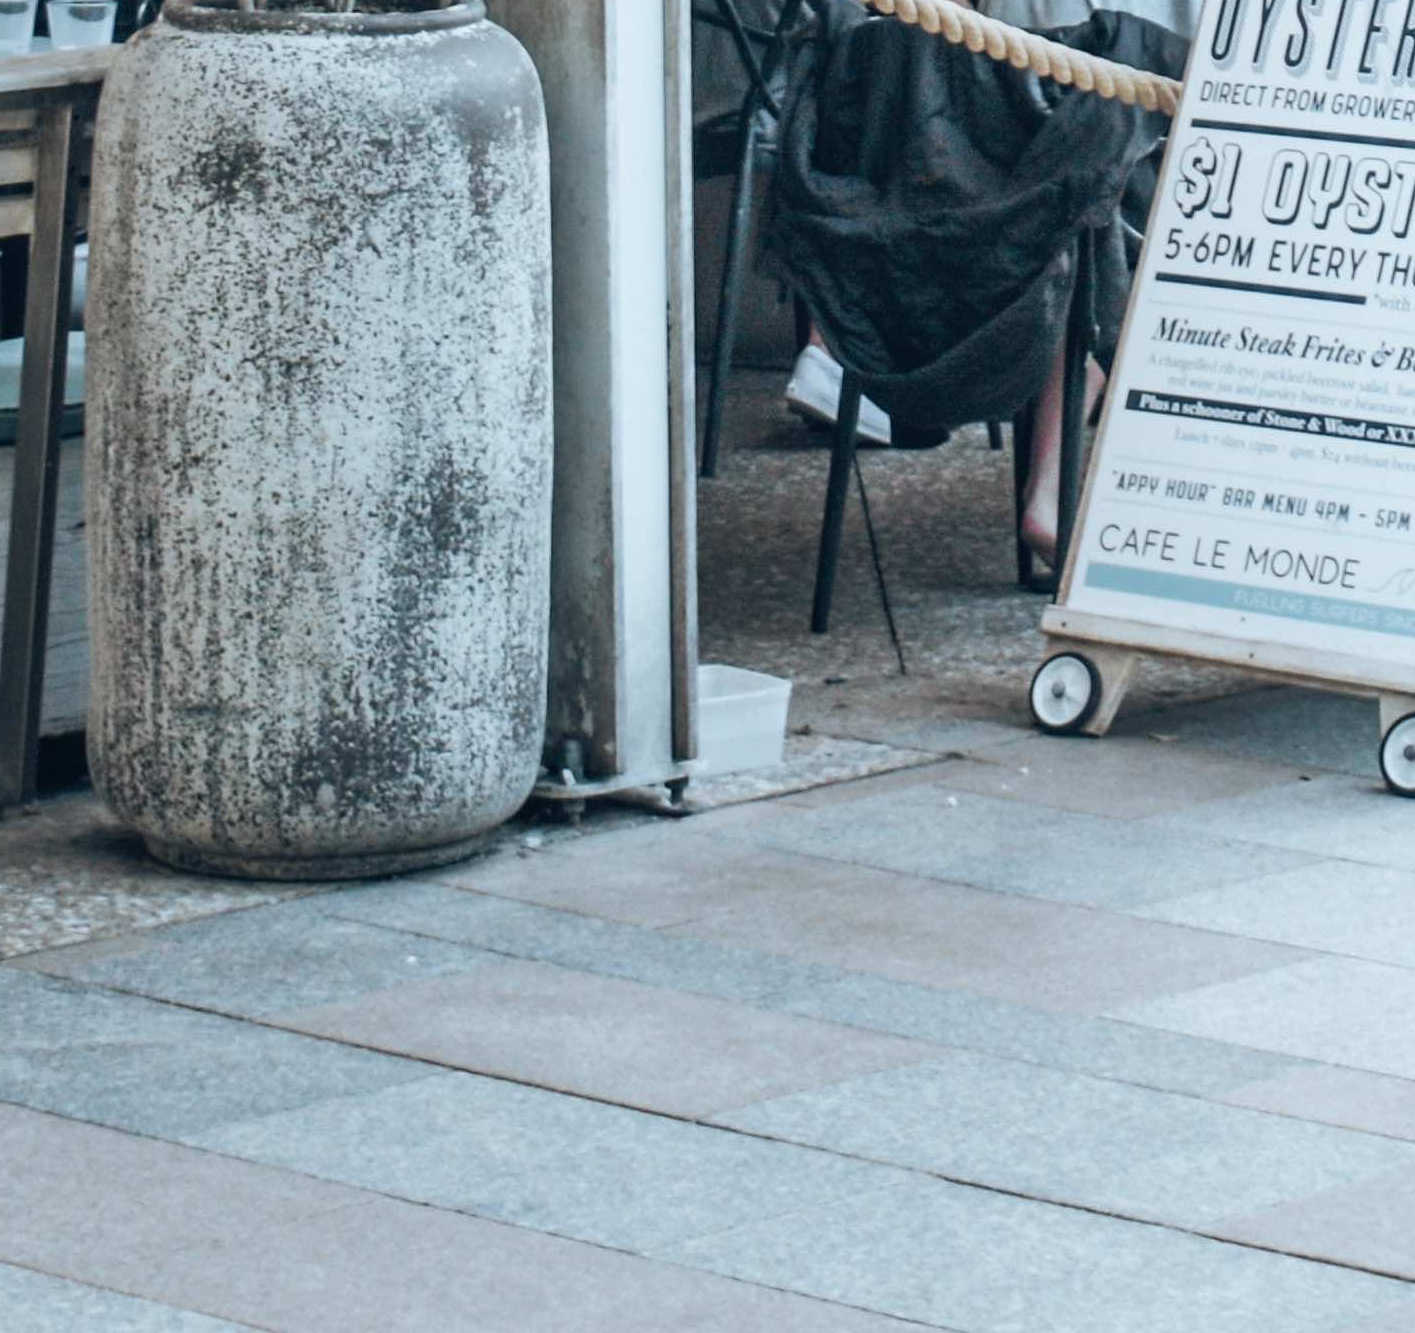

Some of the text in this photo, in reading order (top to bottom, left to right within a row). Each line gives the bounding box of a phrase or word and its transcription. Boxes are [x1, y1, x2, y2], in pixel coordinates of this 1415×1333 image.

[1199, 79, 1269, 109] DIRECT
[1271, 86, 1326, 114] FROM
[1173, 135, 1242, 220] $1
[1163, 227, 1257, 269] 5-6PM
[1268, 239, 1368, 281] EVERY
[1151, 316, 1232, 350] Minute
[1235, 325, 1297, 358] Steak
[1300, 333, 1366, 368] Frites
[1371, 340, 1395, 369] &
[1139, 392, 1171, 412] Plus
[1181, 400, 1246, 422] schooner
[1246, 407, 1266, 425] of
[1263, 409, 1306, 431] Stone
[1323, 416, 1368, 439] Wood
[1366, 427, 1386, 441] or
[1222, 485, 1257, 509] BAR
[1262, 492, 1308, 518] MENU
[1315, 499, 1351, 524] 4PM
[1374, 506, 1412, 534] 5PM
[1098, 522, 1362, 590] CAFE LE MONDE
